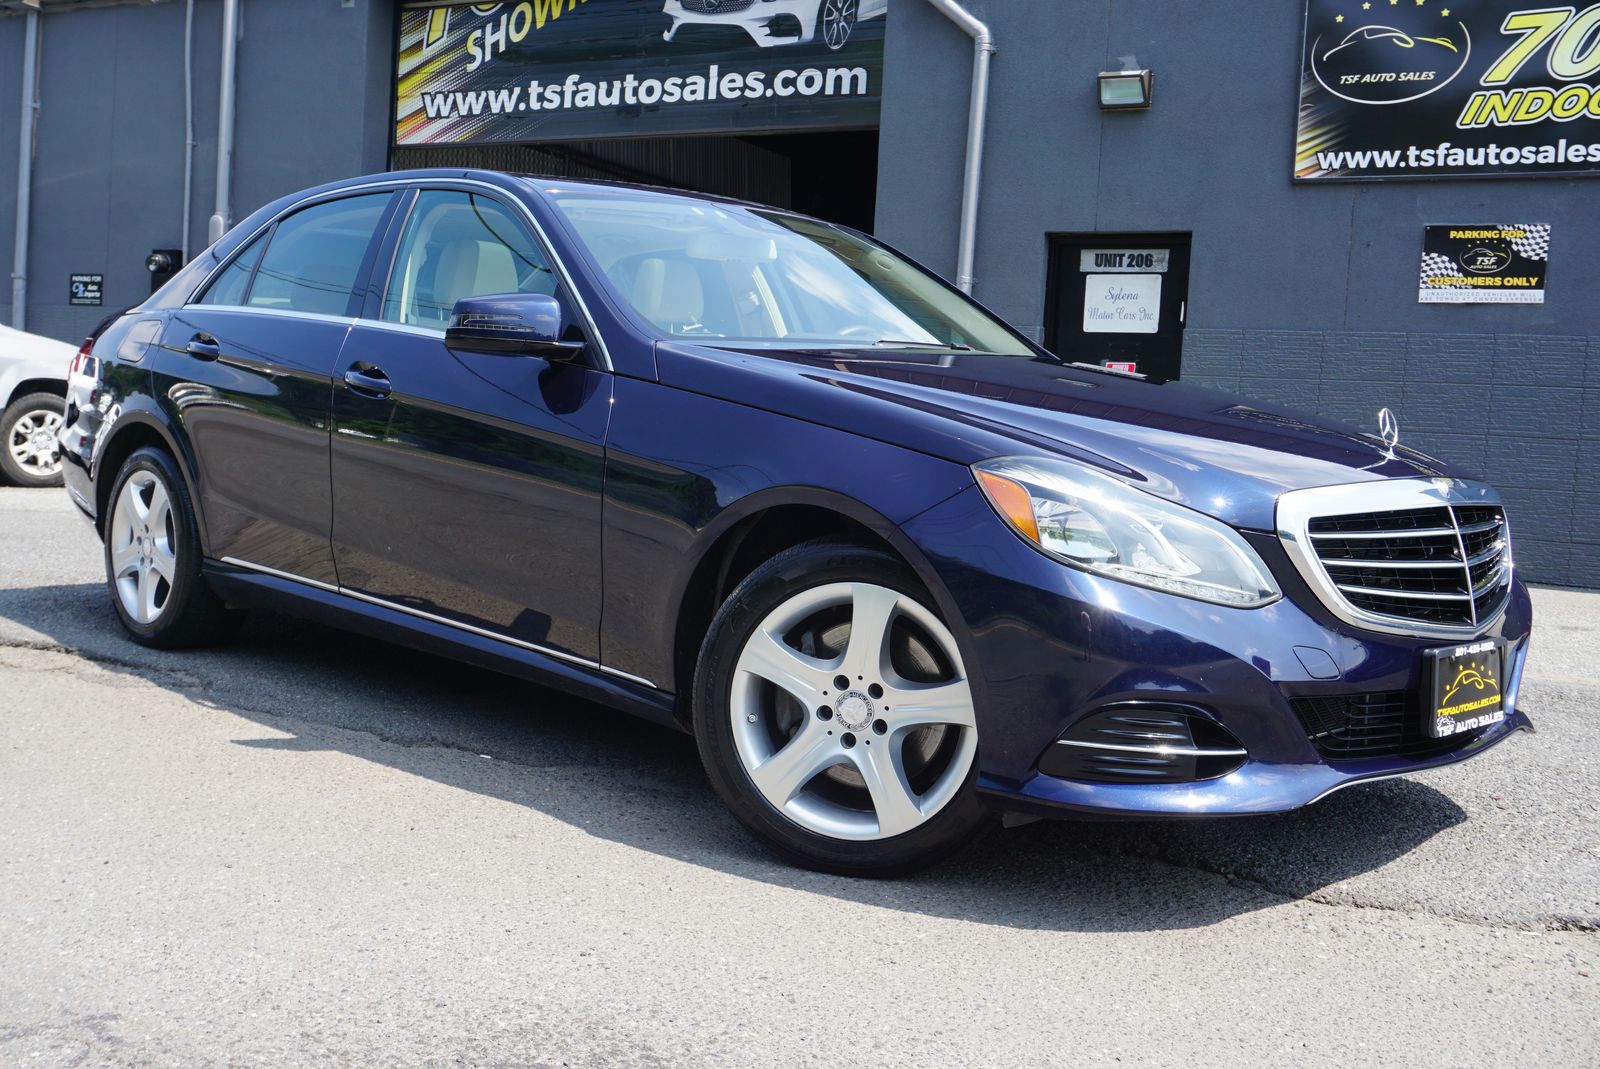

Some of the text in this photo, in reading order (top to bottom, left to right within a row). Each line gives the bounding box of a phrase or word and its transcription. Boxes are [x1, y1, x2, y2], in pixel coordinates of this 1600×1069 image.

[465, 0, 588, 73] SHOW
[1339, 71, 1436, 85] TSF AUTO SALES
[422, 64, 867, 119] www.tsfautosales.com
[1450, 230, 1525, 239] PARKING FOR
[1095, 253, 1154, 268] UNIT 206
[1476, 257, 1498, 265] TSF
[1428, 277, 1538, 287] CUSTOMERS ONLY
[1104, 286, 1139, 304] Sylena
[1087, 306, 1155, 321] Motor Cars Inc.
[1437, 694, 1501, 717] TSFAUTOSALES.COM
[1437, 710, 1504, 737] TSF AUTO SALES
